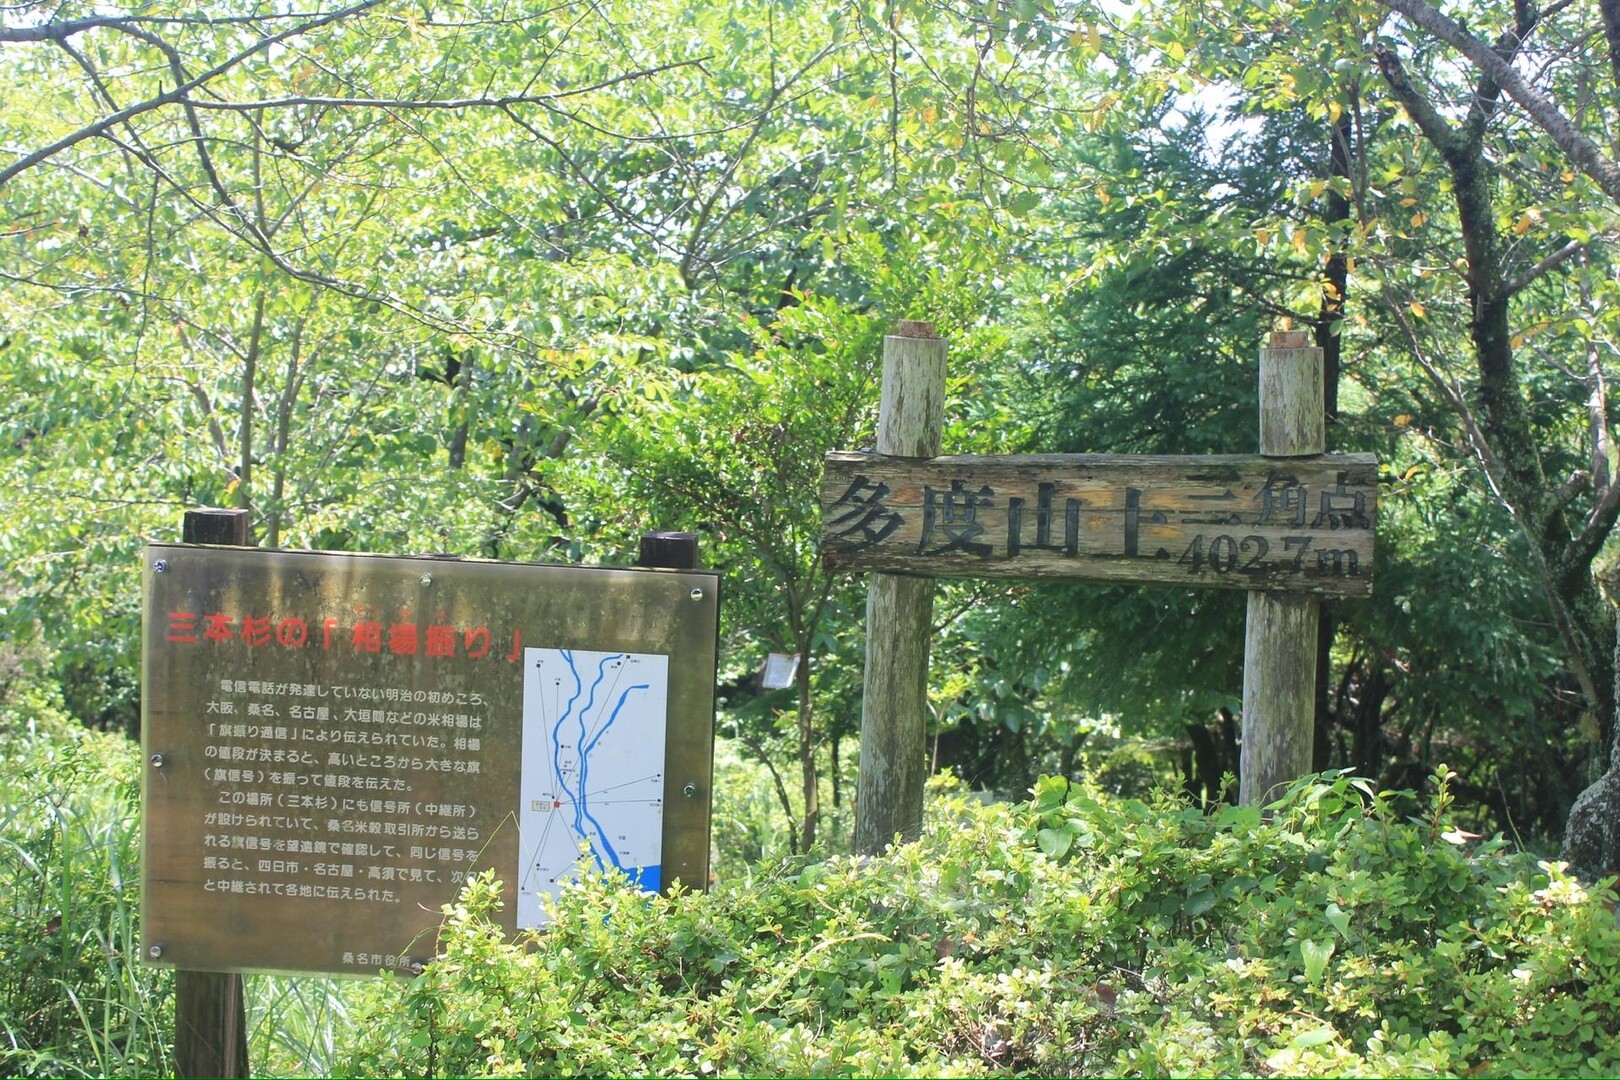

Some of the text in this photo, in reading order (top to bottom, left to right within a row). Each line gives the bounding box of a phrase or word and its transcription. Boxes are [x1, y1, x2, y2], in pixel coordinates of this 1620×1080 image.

[1181, 469, 1371, 530] 三角点
[828, 475, 1170, 561] 多度山上
[220, 679, 488, 707] 電信電話が発達していない明治の初めころ、
[206, 700, 482, 729] 大阪、桑名、名古屋、大垣間などの米相場は
[209, 723, 480, 751] 「旗振り通信」により伝えられていた。相場
[205, 745, 480, 774] の値段が決まると、高いところから大きな旗
[204, 812, 479, 840] が設けられていて、桑名米穀取引所から送ら
[204, 879, 400, 904] と中継されて各地に伝えられた。
[342, 952, 411, 968] 桑名市役所
